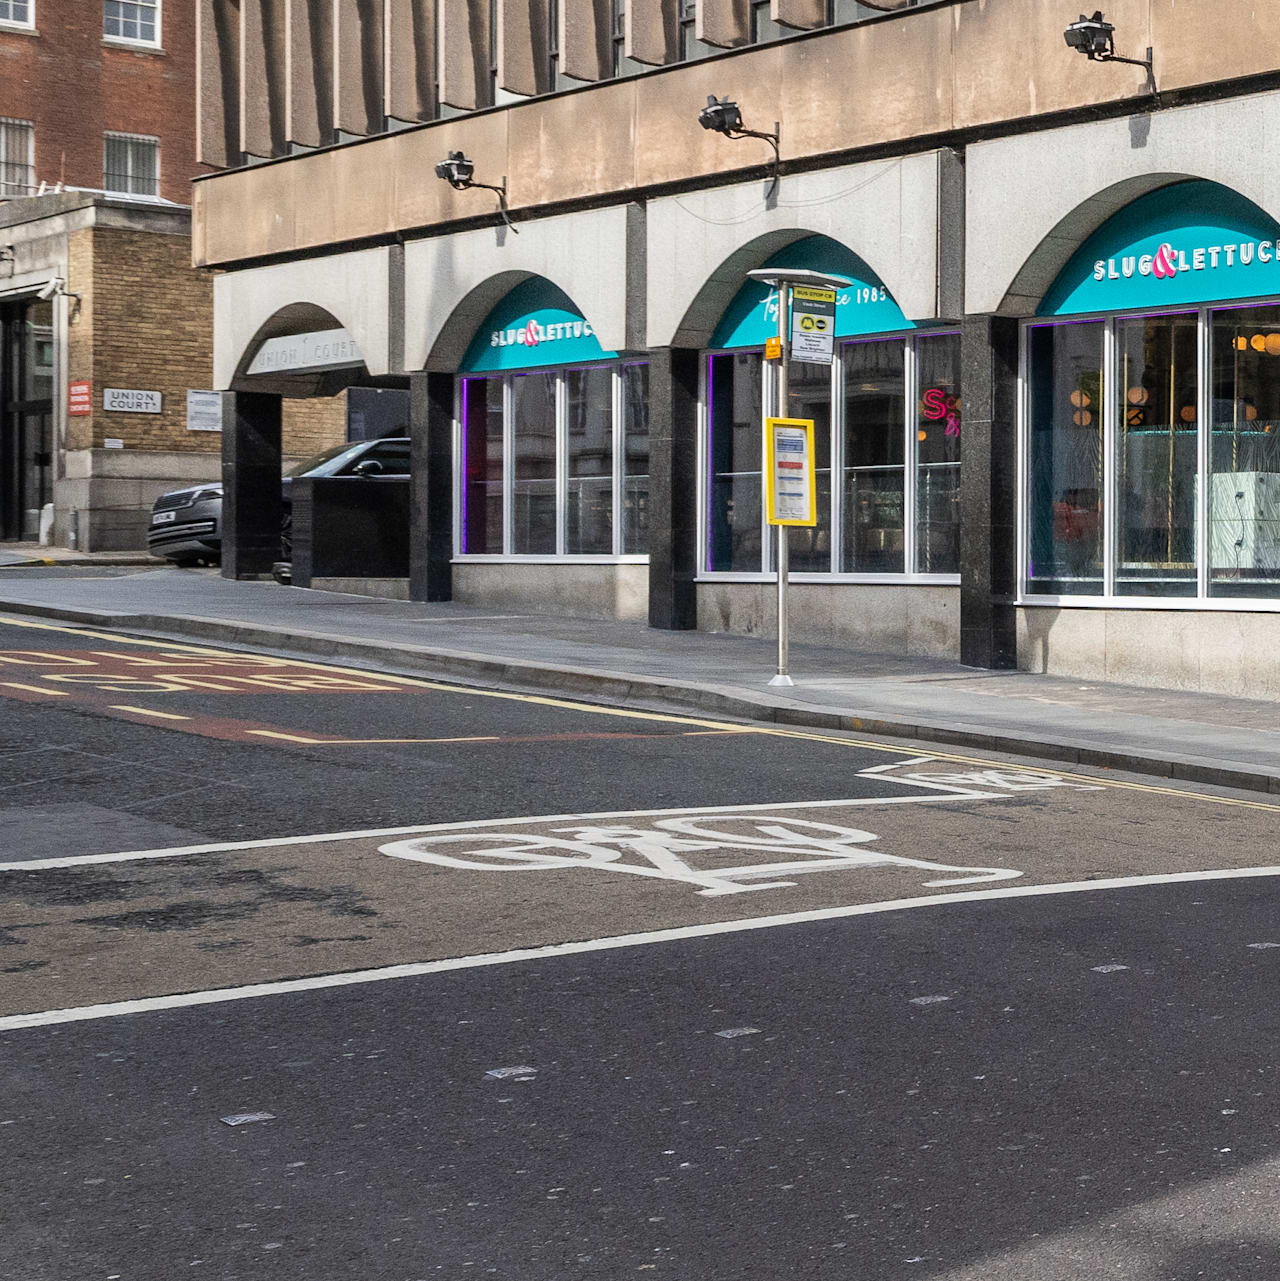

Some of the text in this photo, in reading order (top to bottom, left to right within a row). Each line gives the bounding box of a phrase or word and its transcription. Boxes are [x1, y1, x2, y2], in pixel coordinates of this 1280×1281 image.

[857, 285, 887, 305] 1985
[490, 319, 594, 348] SLUG&LETTUC
[111, 391, 154, 401] UNION
[110, 400, 151, 410] COURT
